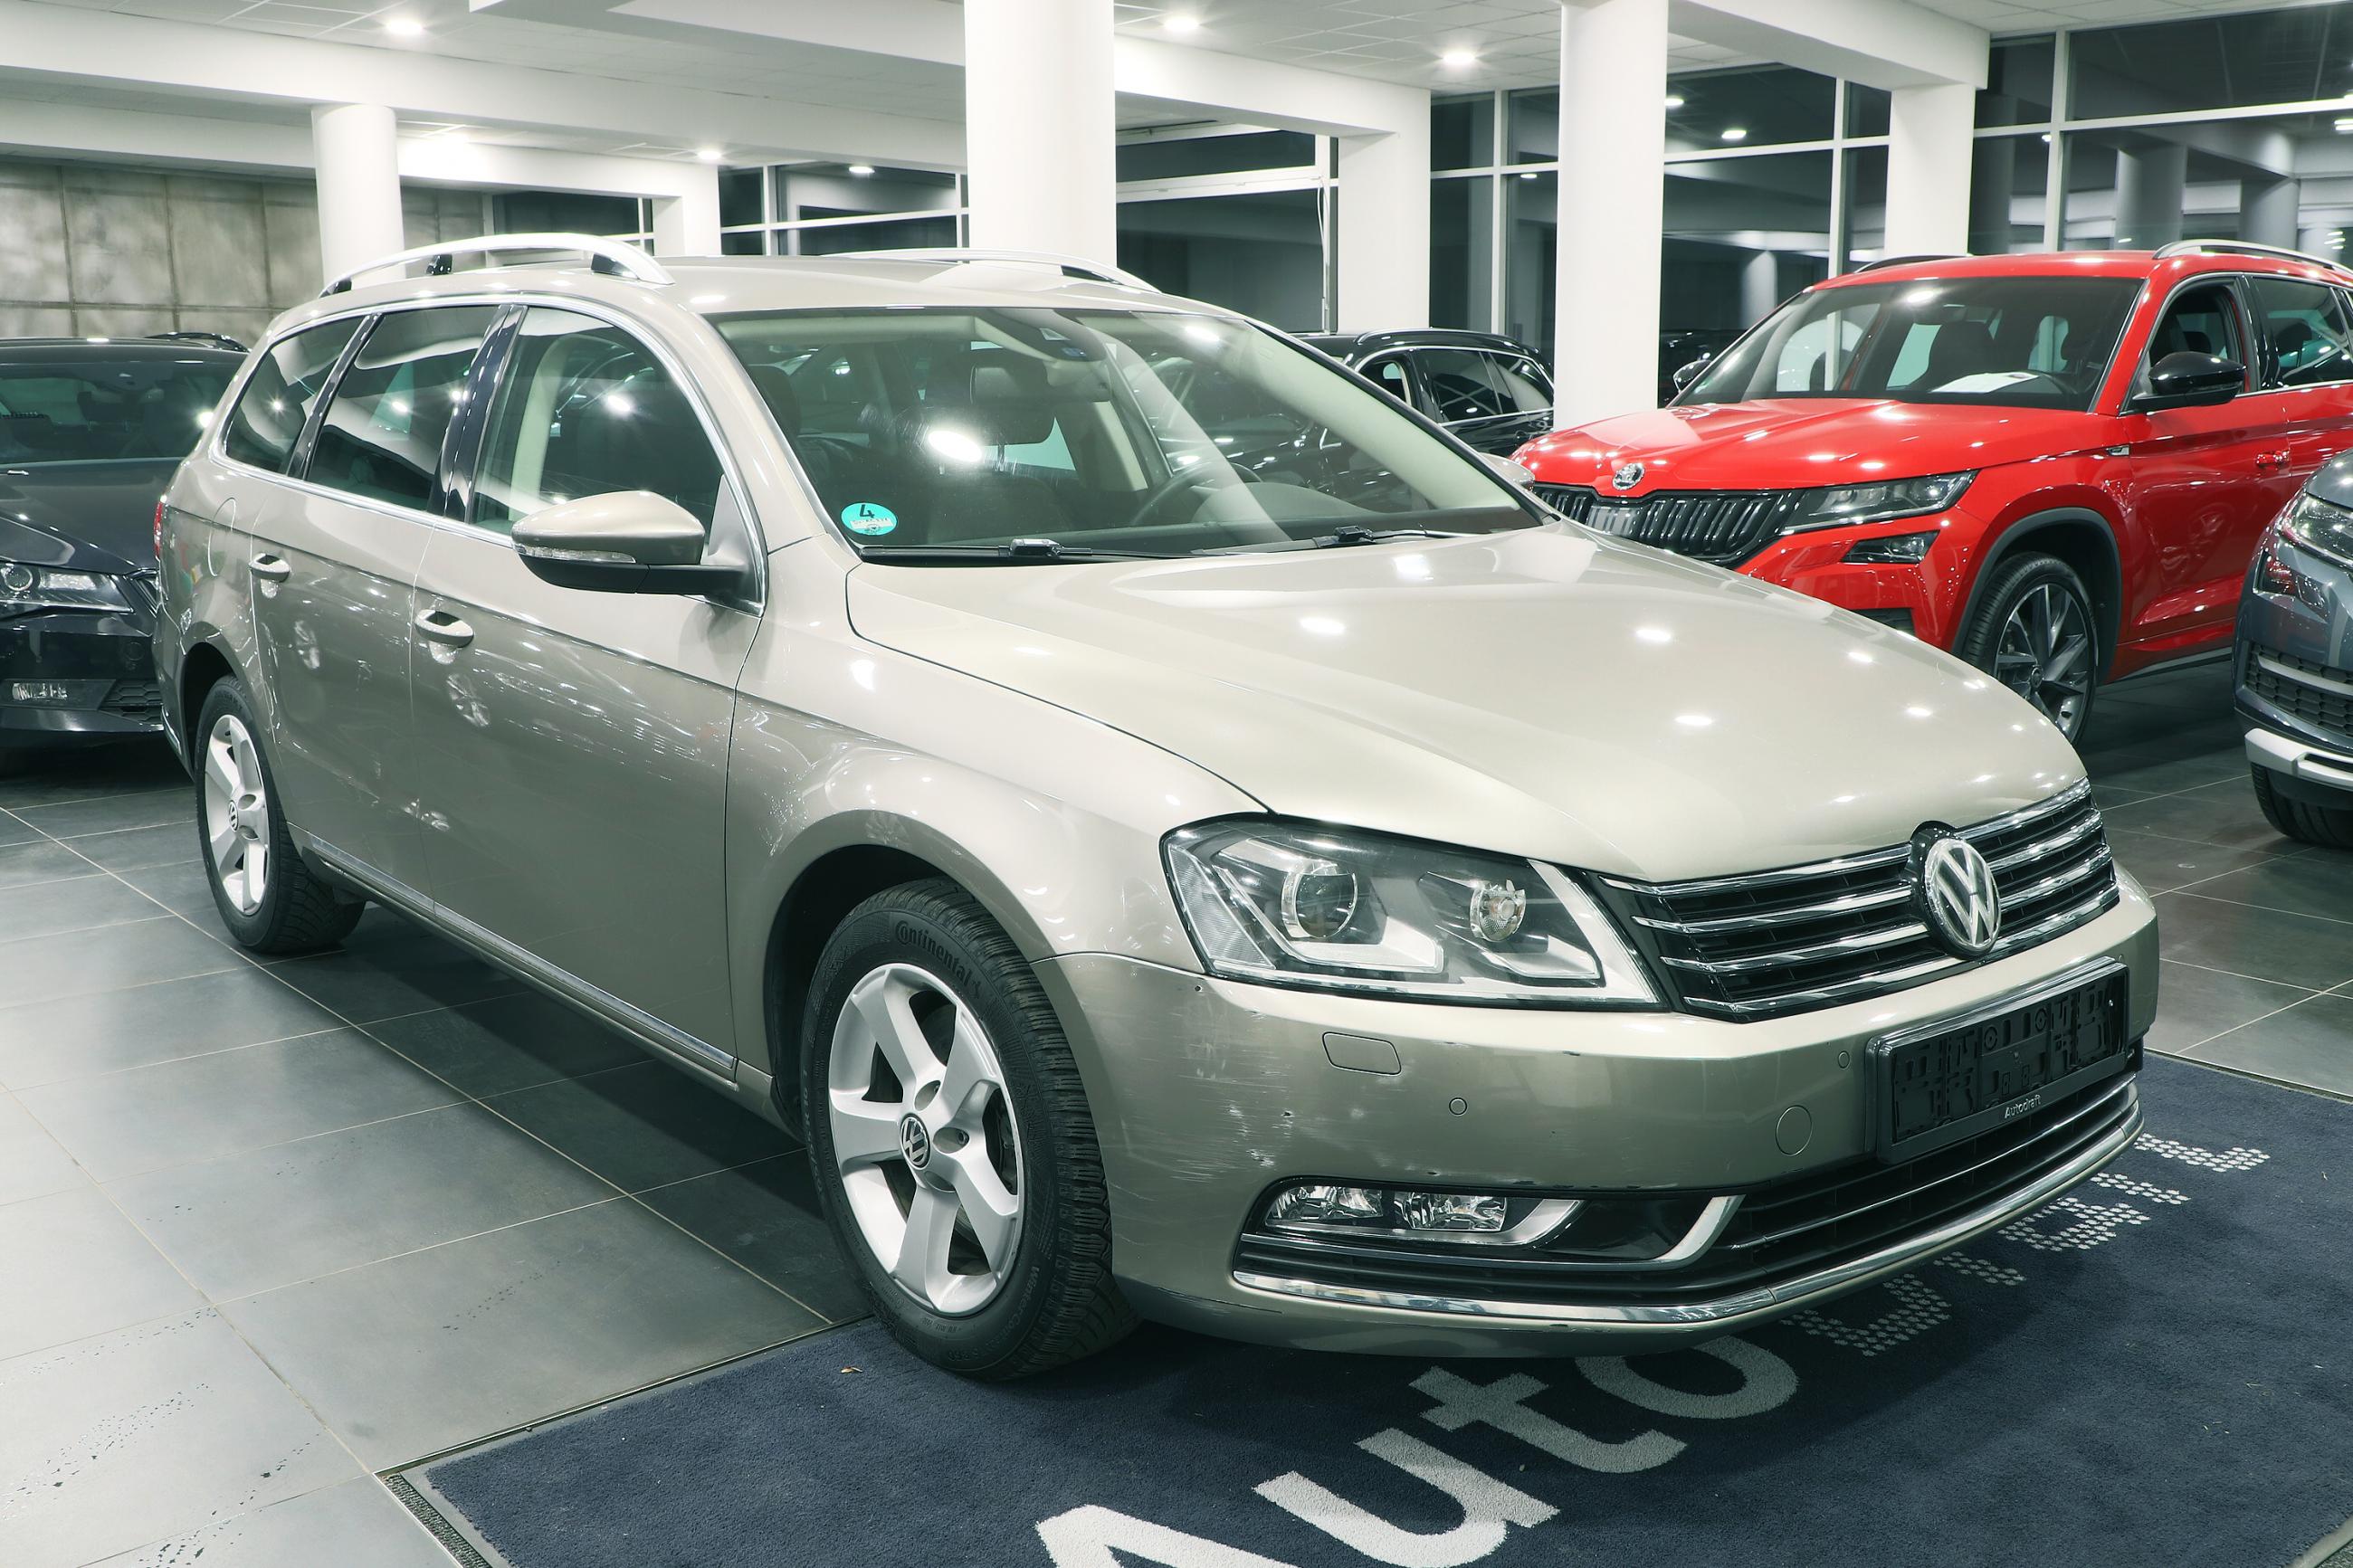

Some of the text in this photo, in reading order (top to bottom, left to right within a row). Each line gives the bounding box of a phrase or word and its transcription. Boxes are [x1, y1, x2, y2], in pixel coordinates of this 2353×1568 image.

[859, 503, 875, 518] 4
[1925, 838, 2001, 947] VW
[895, 919, 973, 986] Continental
[900, 1116, 929, 1167] VW
